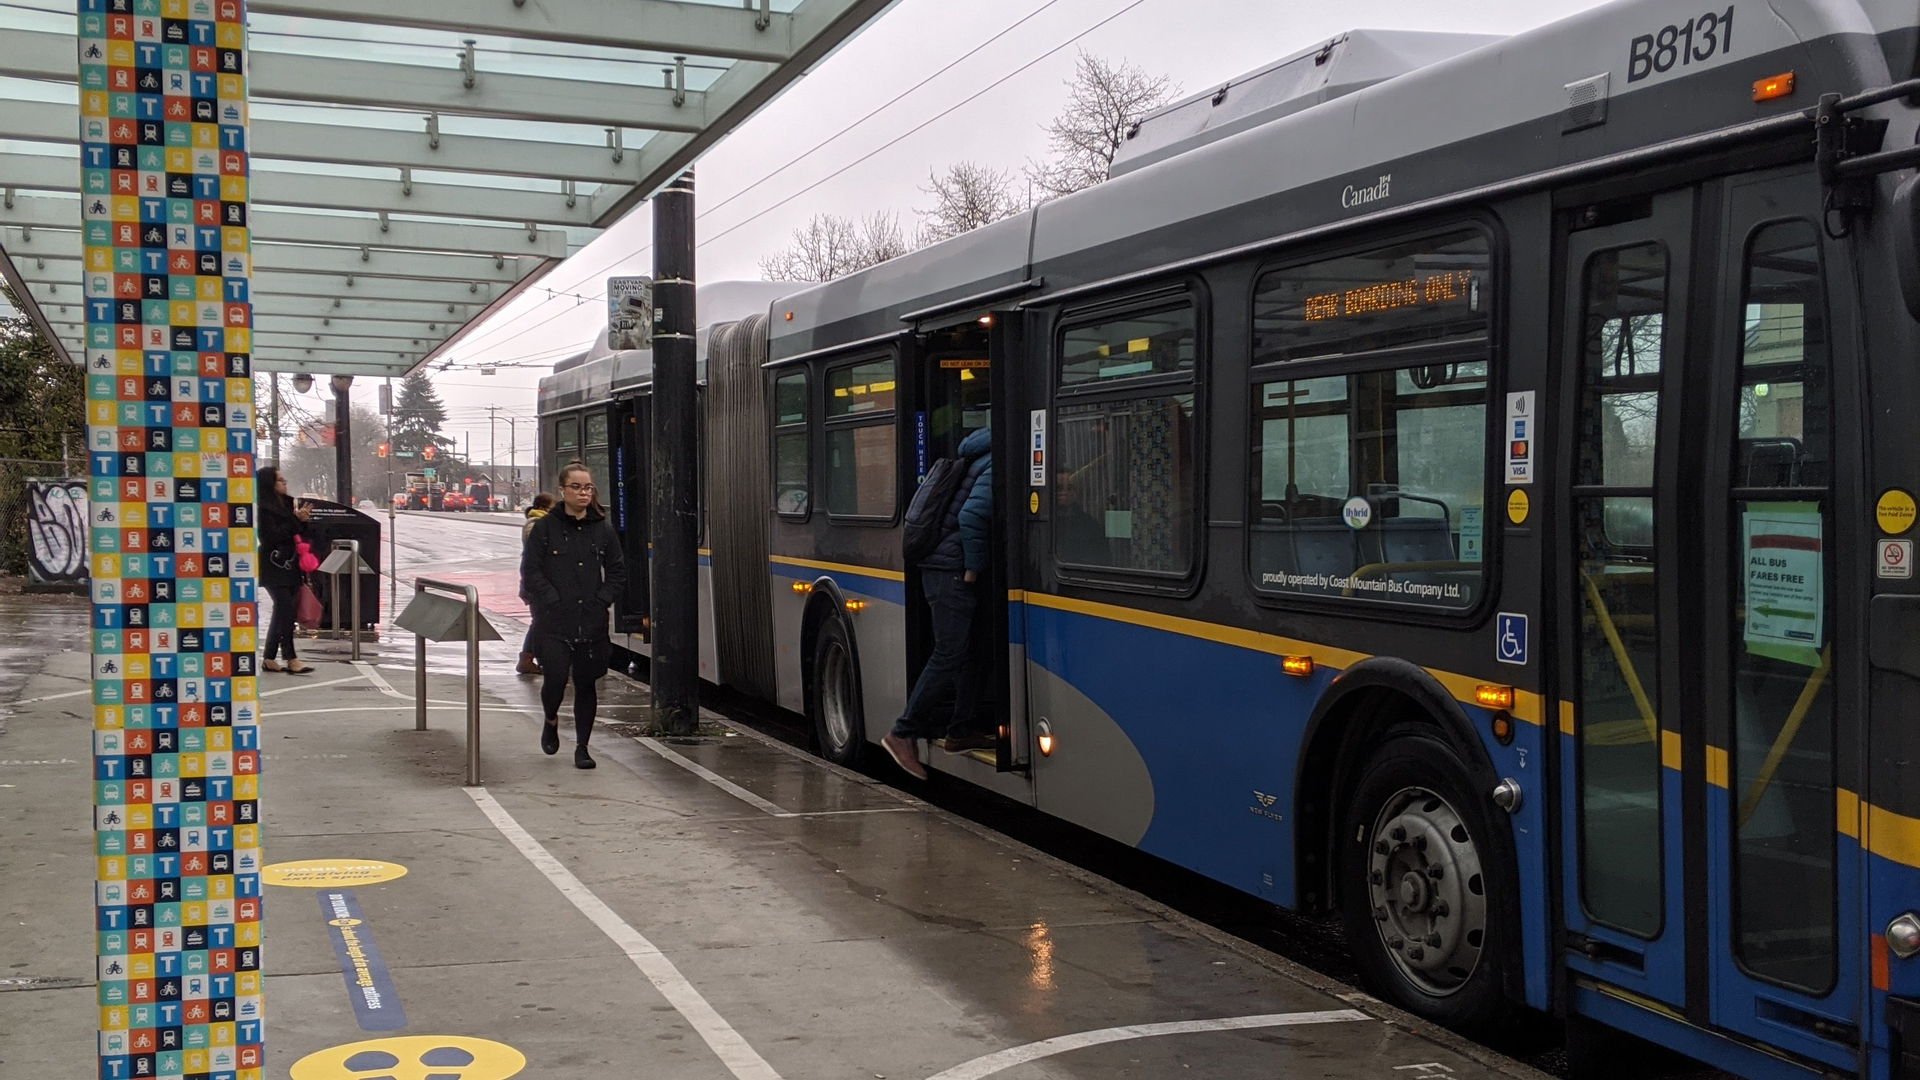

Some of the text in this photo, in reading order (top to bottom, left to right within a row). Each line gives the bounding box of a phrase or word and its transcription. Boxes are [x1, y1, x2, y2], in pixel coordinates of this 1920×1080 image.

[1628, 4, 1734, 84] B8131
[1342, 174, 1391, 208] Canada
[1304, 270, 1472, 321] REAR BOARDING ONLY
[1512, 467, 1526, 475] VISA
[1346, 508, 1368, 518] Hybrid
[1751, 557, 1787, 567] ALL BUS
[1262, 571, 1460, 599] proudly operated by Coast Mountain Bus Company Ltd.
[1751, 571, 1804, 584] FARES FREE
[356, 968, 374, 986] average
[362, 987, 381, 1009] mattress
